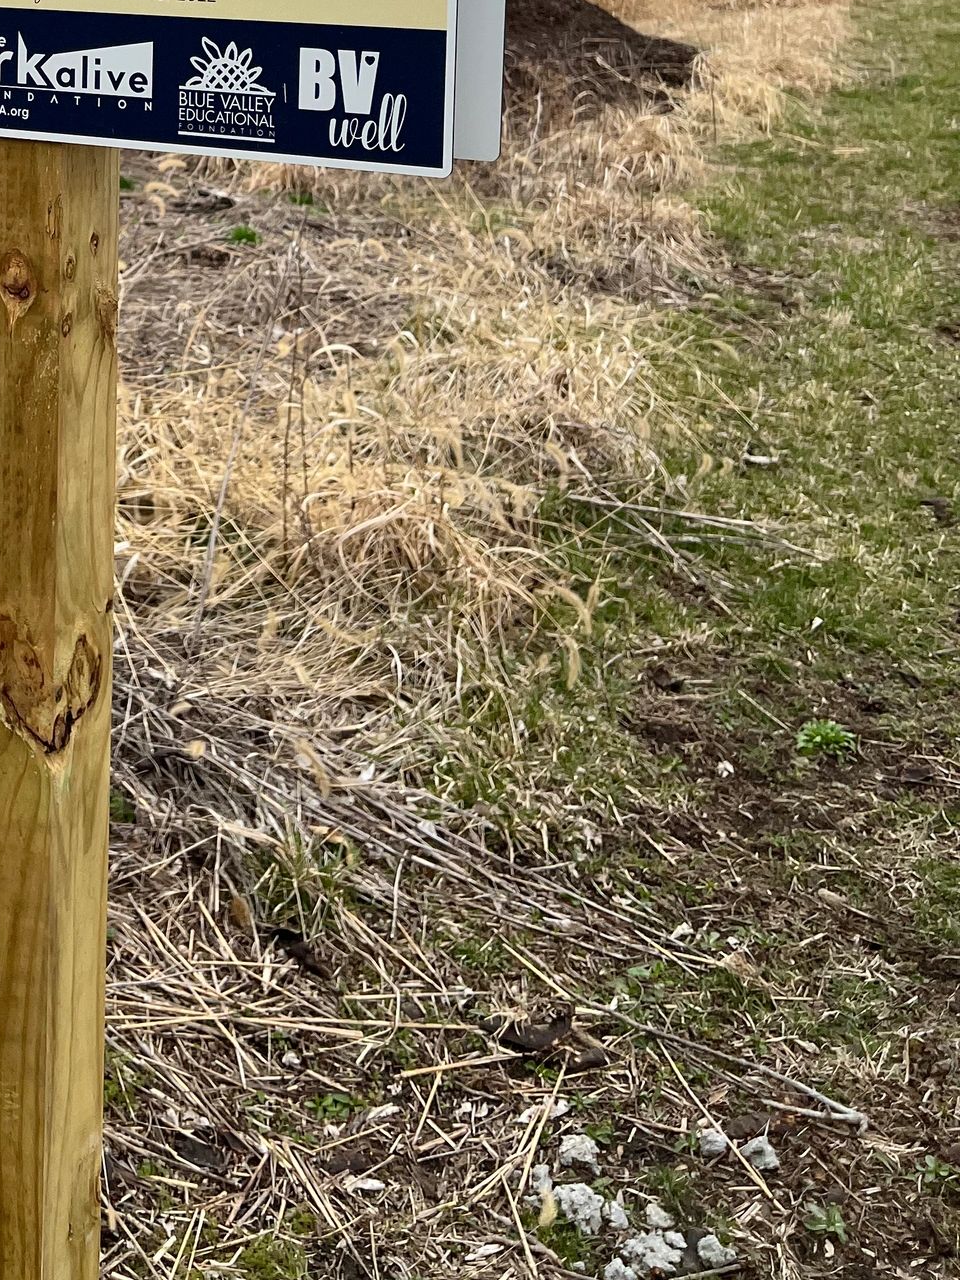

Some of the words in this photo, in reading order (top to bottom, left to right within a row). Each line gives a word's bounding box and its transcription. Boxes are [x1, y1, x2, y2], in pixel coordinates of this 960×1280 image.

[298, 47, 381, 115] BV
[178, 91, 216, 110] BLUE
[220, 94, 275, 114] VALLEY
[178, 107, 276, 129] EDUCATIONAL
[329, 93, 408, 153] well
[178, 122, 276, 138] FOUNDATION
